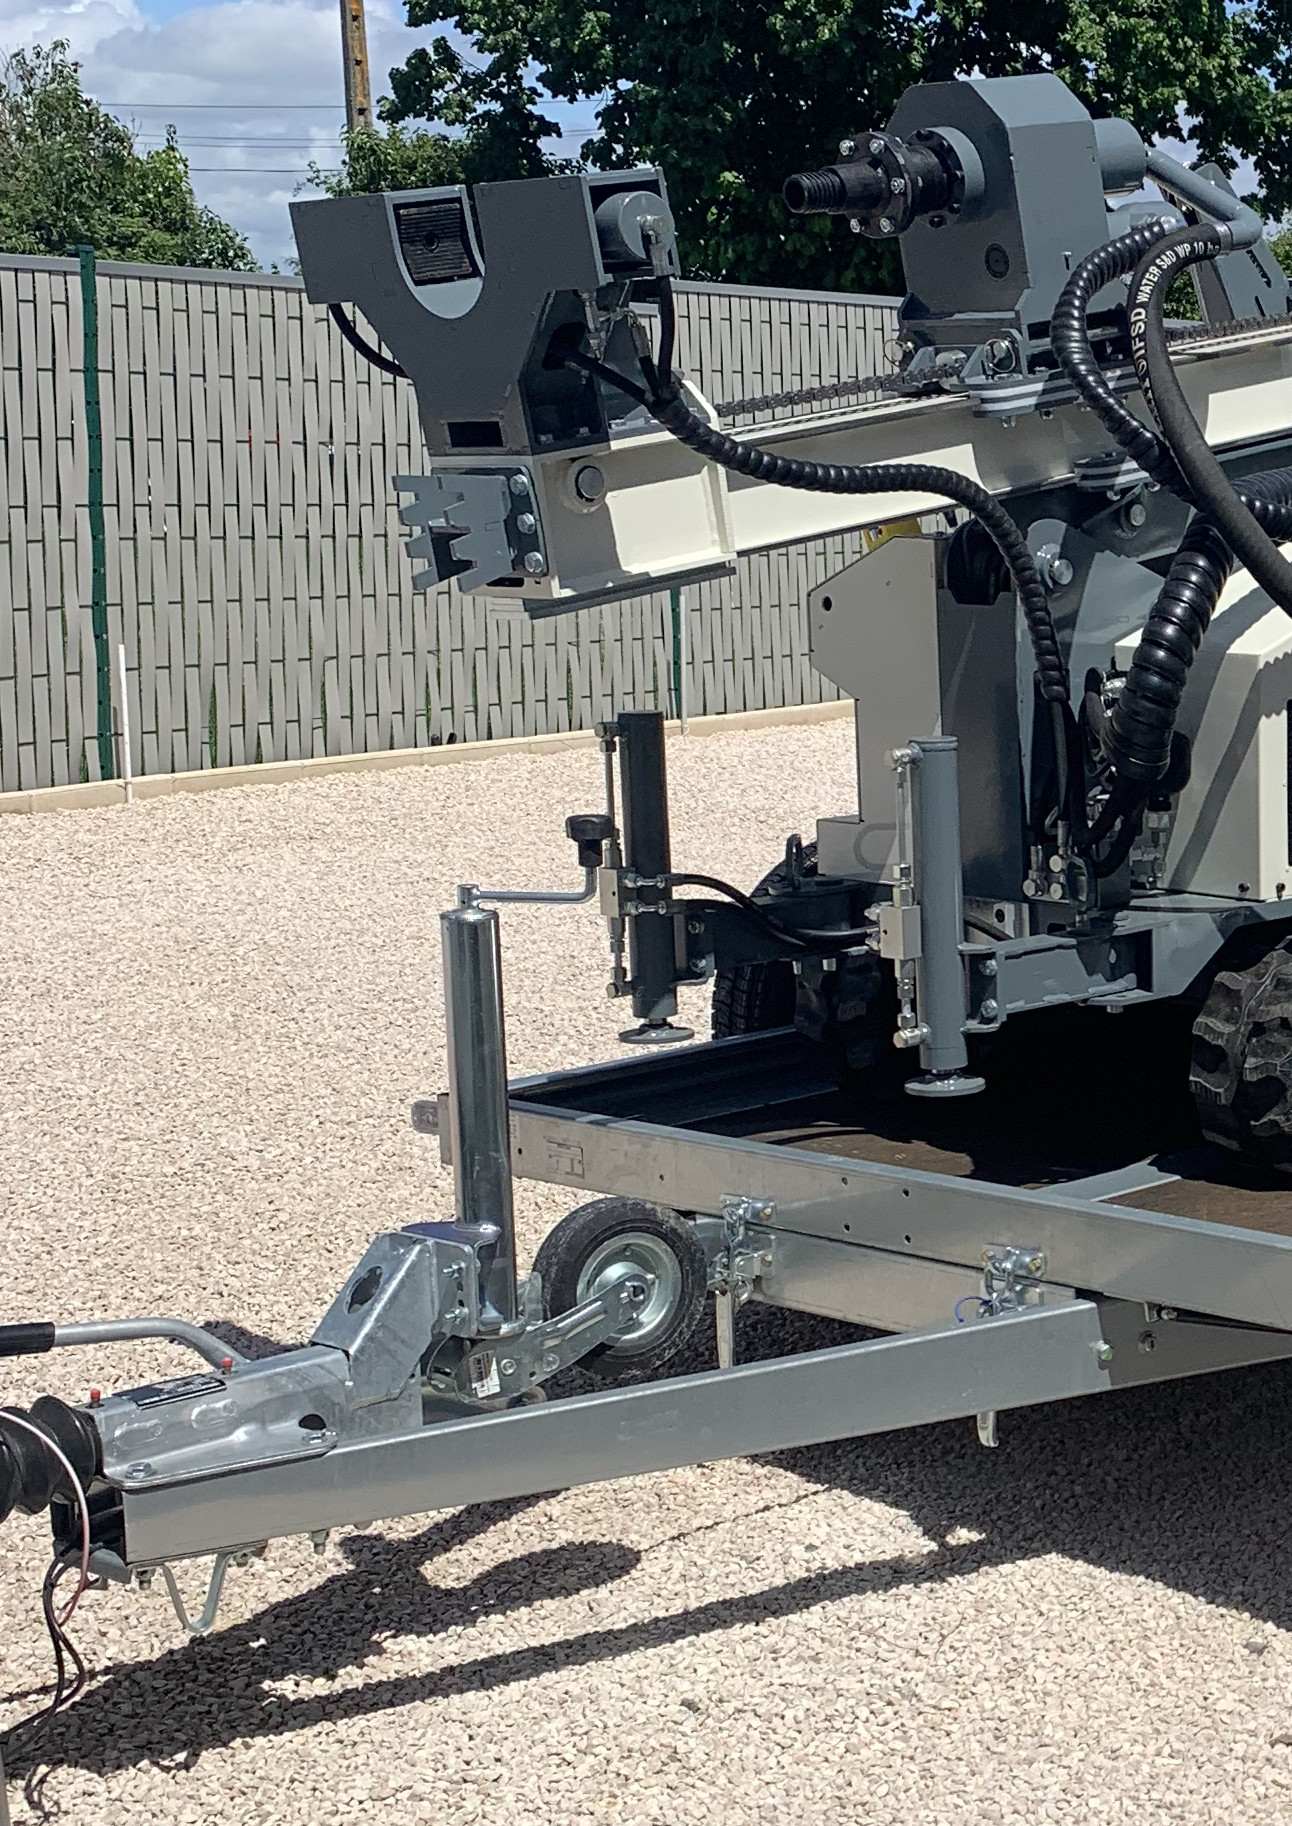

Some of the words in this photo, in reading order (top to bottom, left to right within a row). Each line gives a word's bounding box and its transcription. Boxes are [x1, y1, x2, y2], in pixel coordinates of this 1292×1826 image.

[1135, 265, 1162, 304] WATER
[1155, 249, 1177, 270] S&D
[1173, 242, 1191, 259] WP
[1193, 241, 1205, 255] 10
